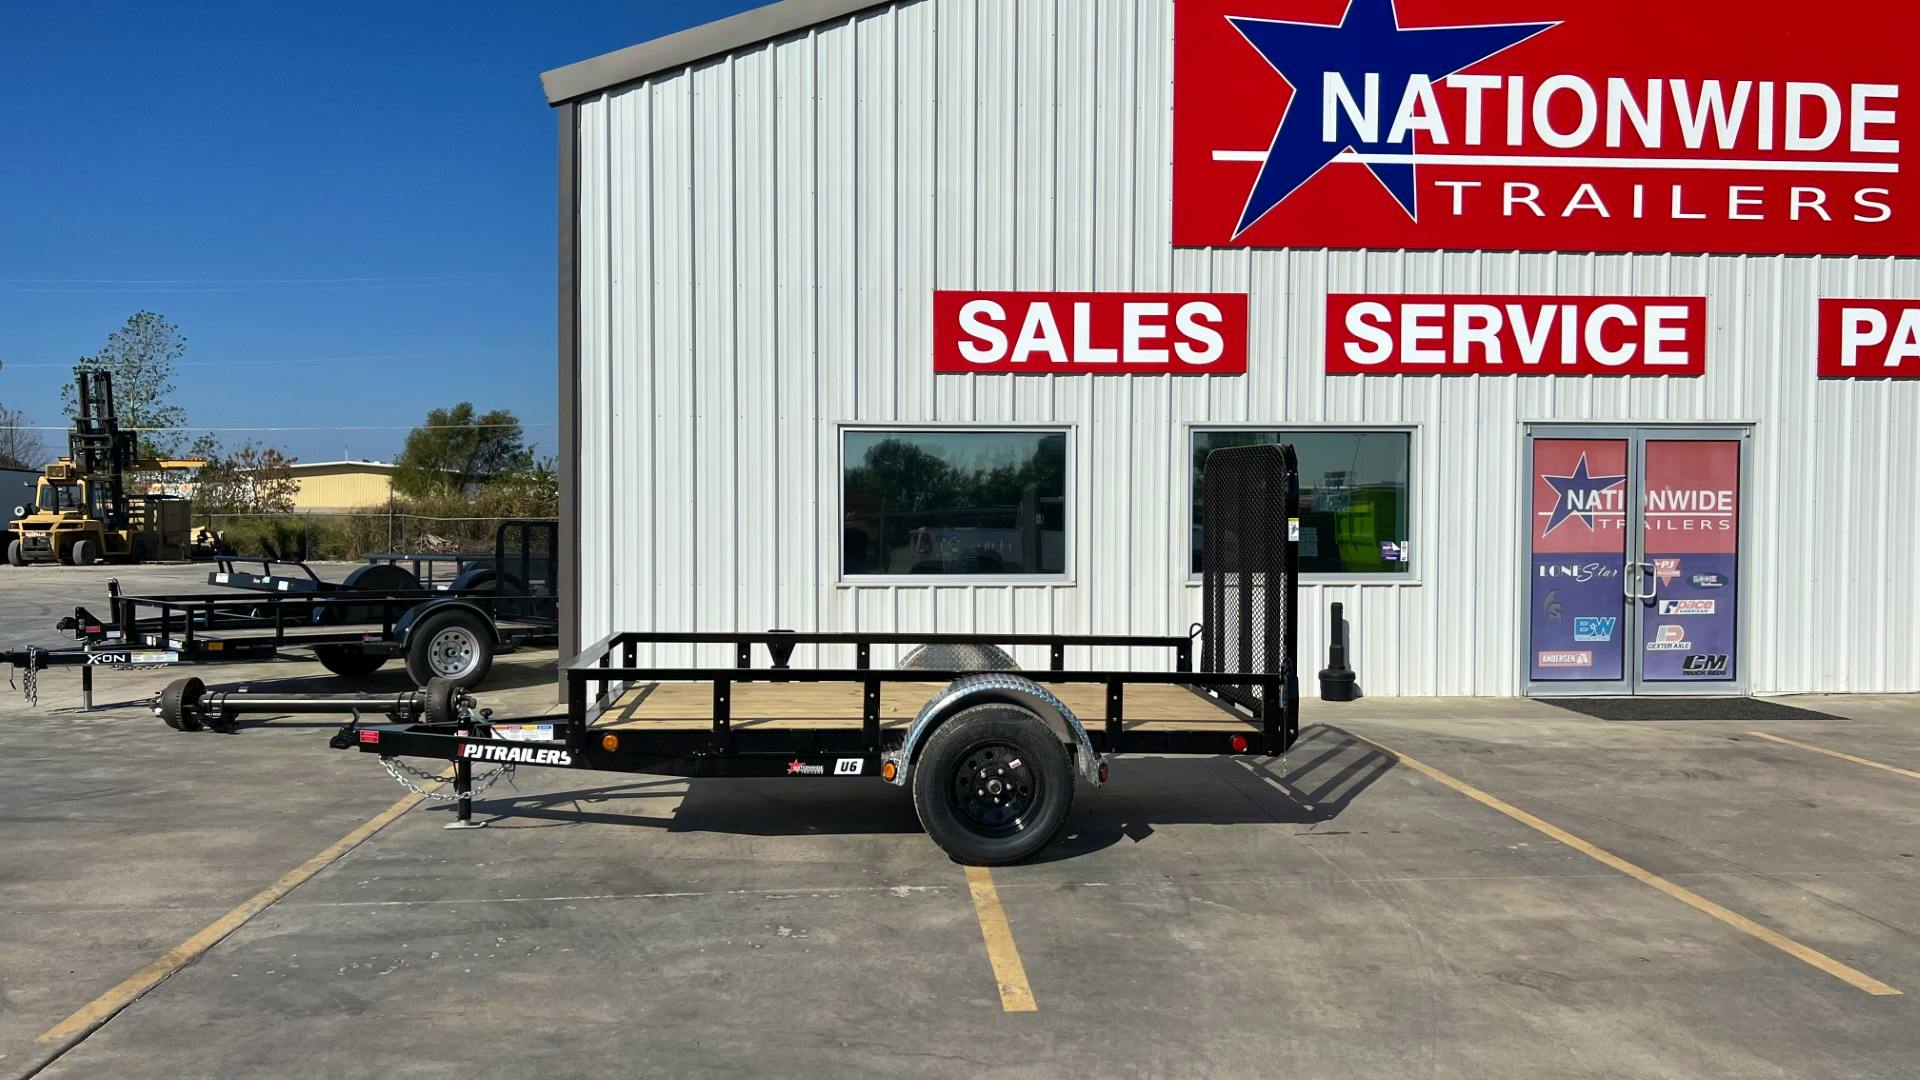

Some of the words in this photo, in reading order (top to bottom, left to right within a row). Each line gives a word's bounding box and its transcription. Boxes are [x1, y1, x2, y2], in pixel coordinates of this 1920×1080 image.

[1322, 71, 1899, 154] NATIONWIDE
[1434, 180, 1893, 223] TRAILERS
[957, 299, 1224, 365] SALES
[1343, 301, 1690, 367] SERVICE
[1567, 489, 1733, 511] NATINWIDE
[840, 761, 858, 772] U6
